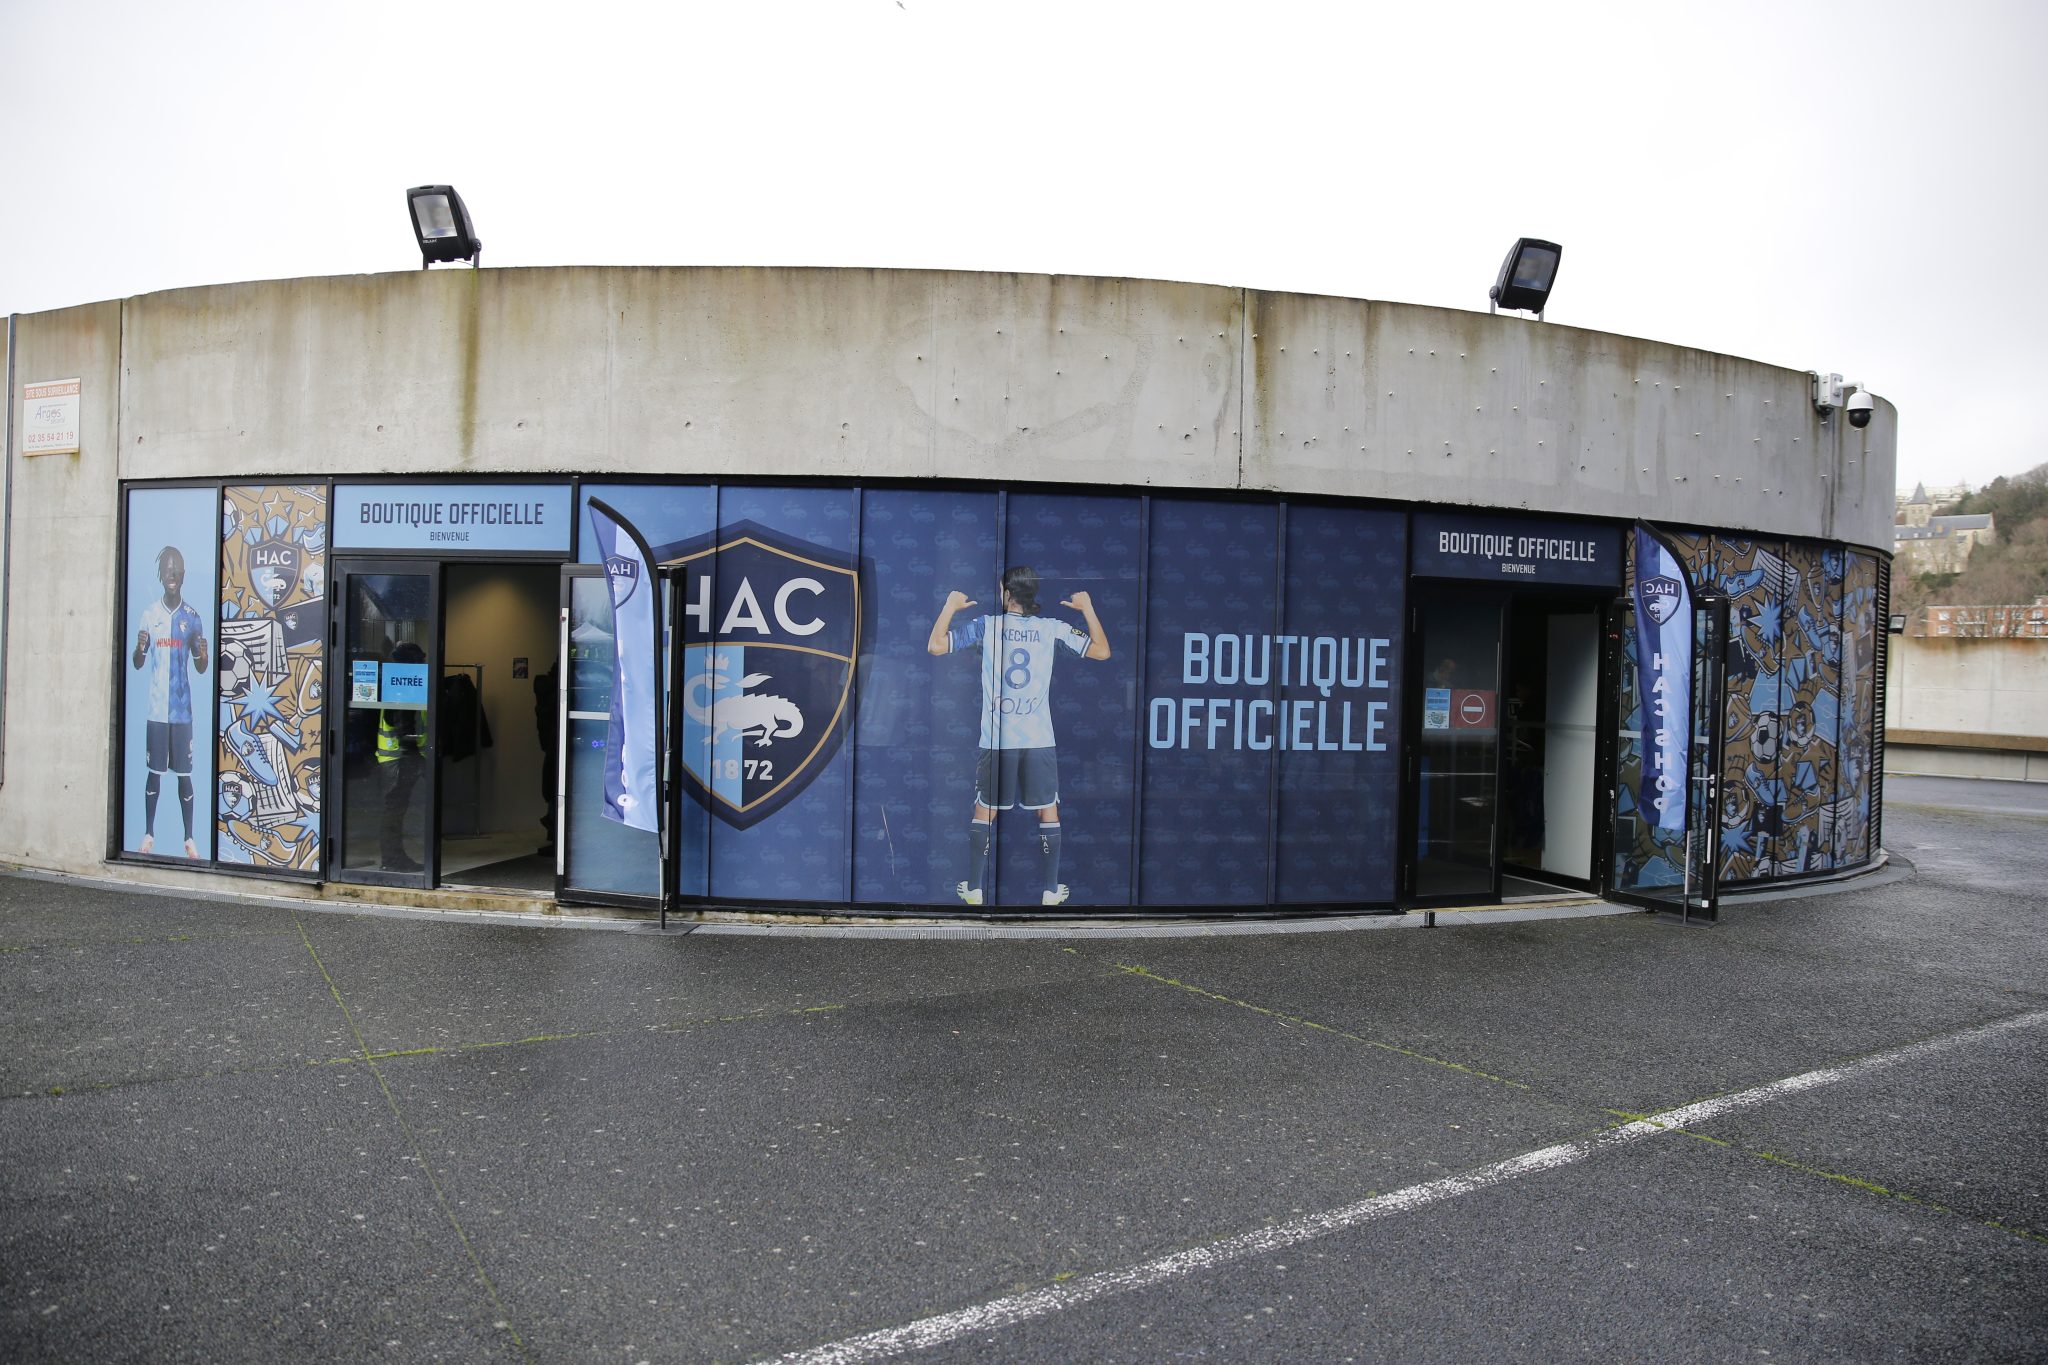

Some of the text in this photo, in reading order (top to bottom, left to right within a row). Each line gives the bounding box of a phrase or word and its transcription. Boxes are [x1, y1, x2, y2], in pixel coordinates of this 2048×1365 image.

[360, 502, 544, 528] BOUTIQUE OFFICIELLE
[429, 531, 470, 542] BIENVENUE
[1439, 531, 1596, 562] BOUTIQUE OFFICIELLE
[256, 550, 292, 565] HAC
[1501, 563, 1536, 574] BIENVENUE
[1001, 629, 1040, 643] KECHTA
[1004, 647, 1031, 690] 8
[1183, 632, 1390, 697] BOUTIQUE
[390, 675, 423, 687] ENTRÉE
[1149, 697, 1388, 751] OFFICIELLE
[711, 759, 773, 780] 1872
